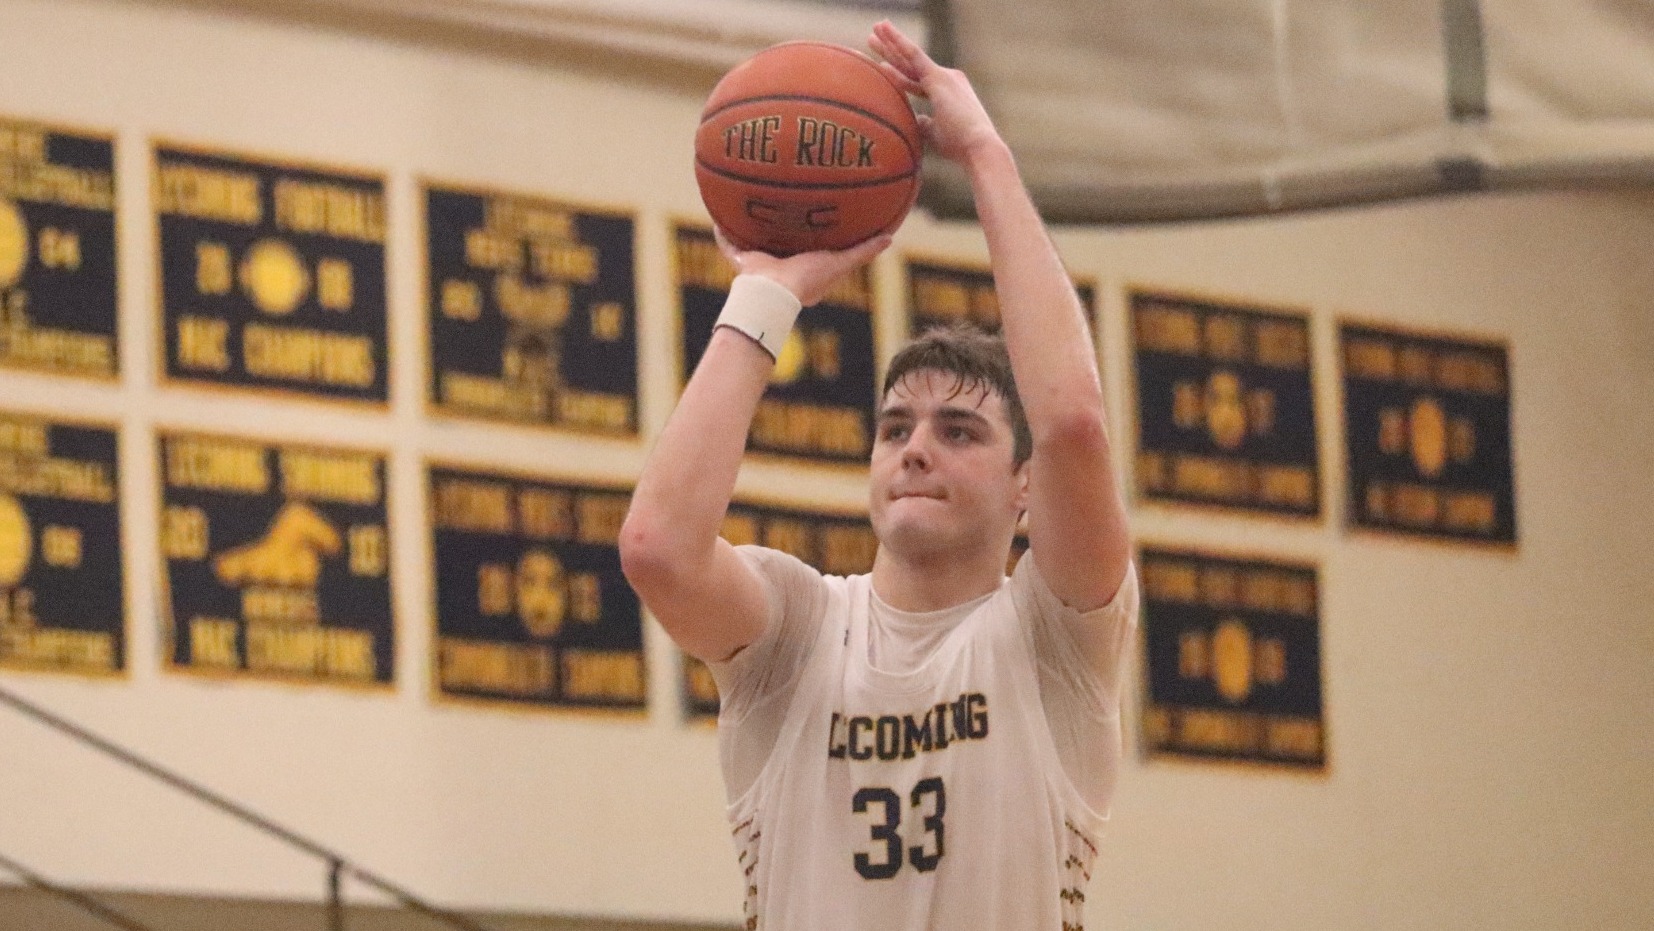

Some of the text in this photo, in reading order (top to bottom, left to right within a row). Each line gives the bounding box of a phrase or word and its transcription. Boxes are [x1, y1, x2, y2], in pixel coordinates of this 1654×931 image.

[721, 115, 877, 169] THE ROCK
[828, 692, 989, 761] LCOMING
[851, 776, 947, 881] 33
